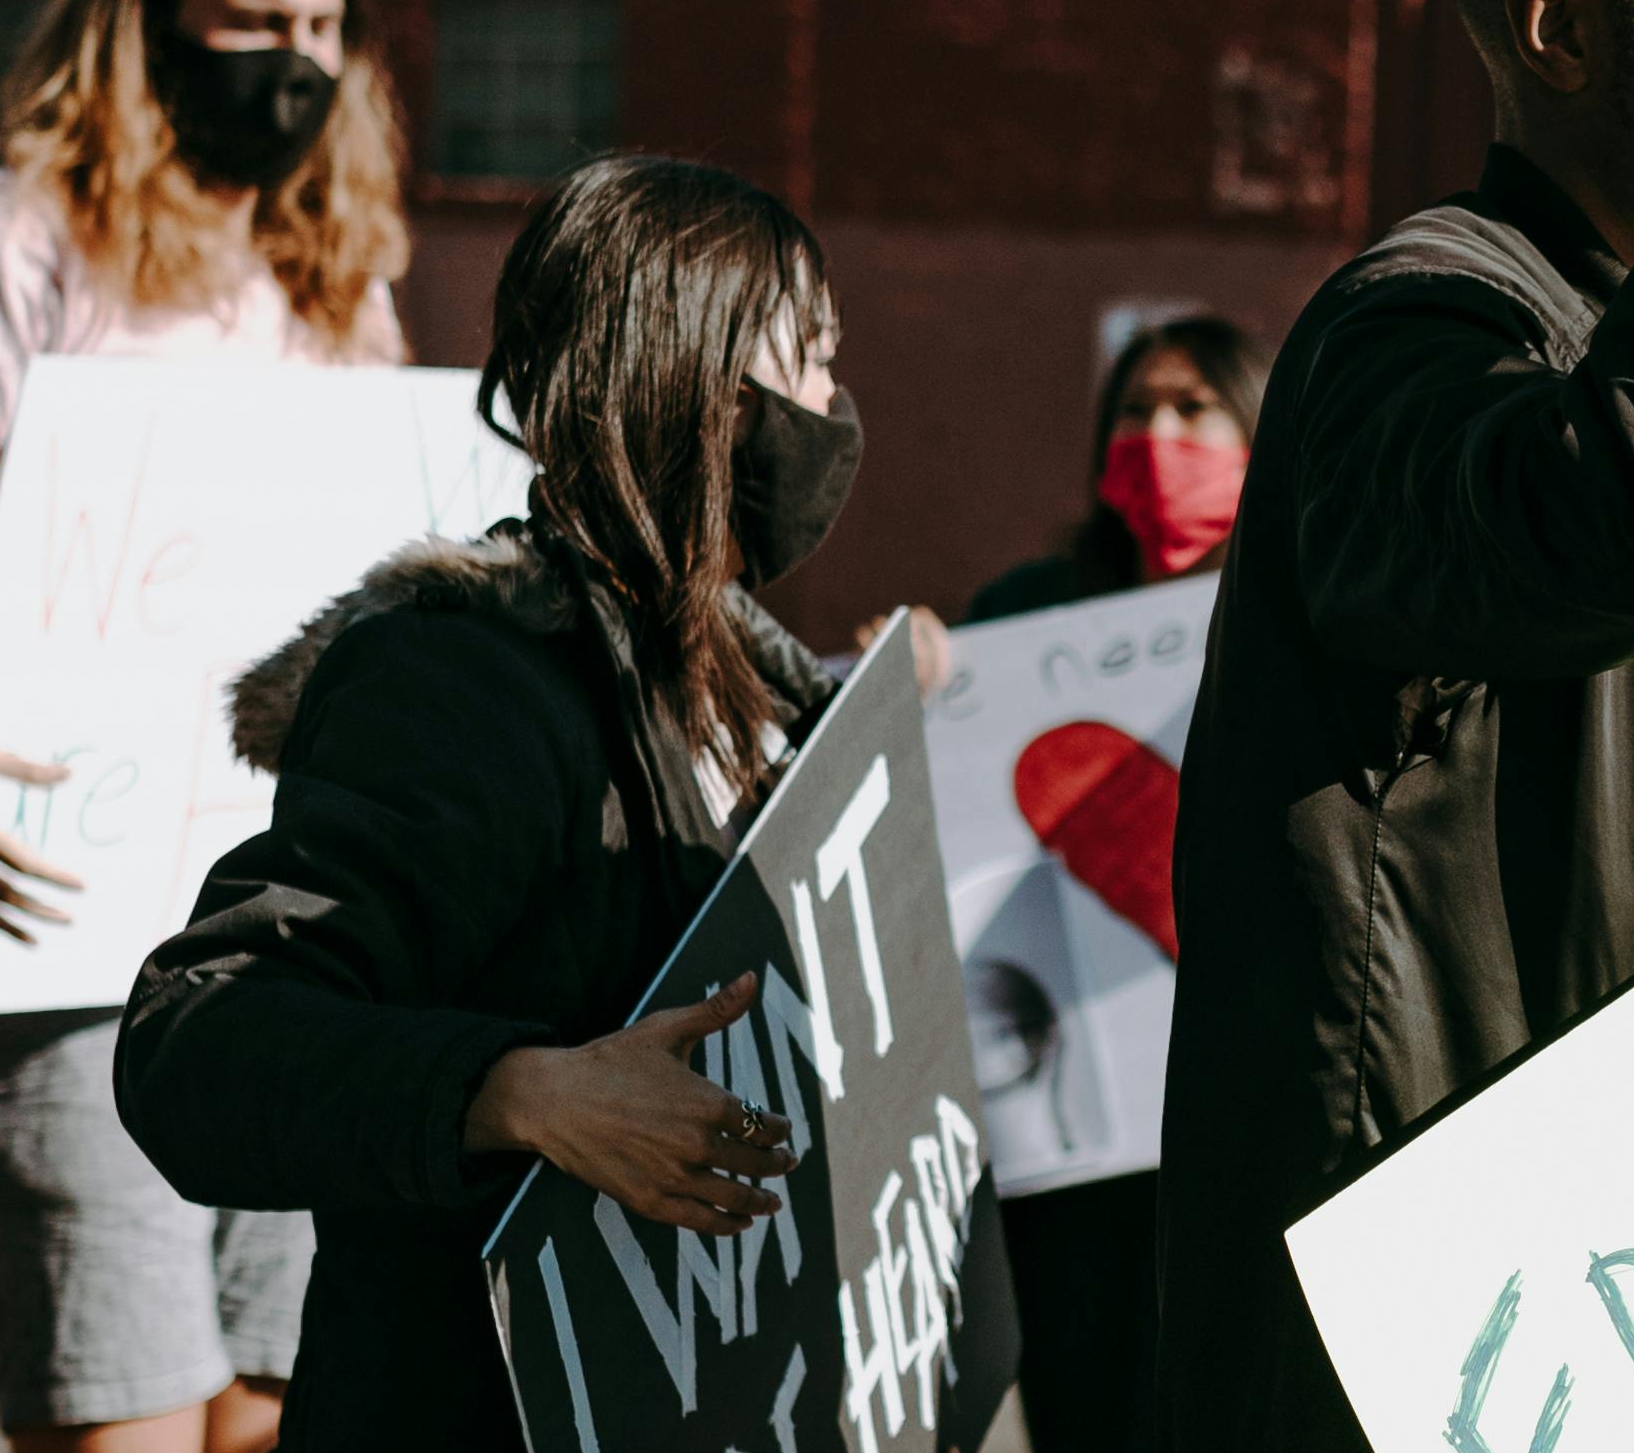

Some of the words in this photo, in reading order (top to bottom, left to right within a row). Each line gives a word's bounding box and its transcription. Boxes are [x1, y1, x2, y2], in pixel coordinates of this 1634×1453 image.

[40, 406, 204, 644] We
[1038, 618, 1208, 700] nee
[594, 754, 893, 1416] WANT
